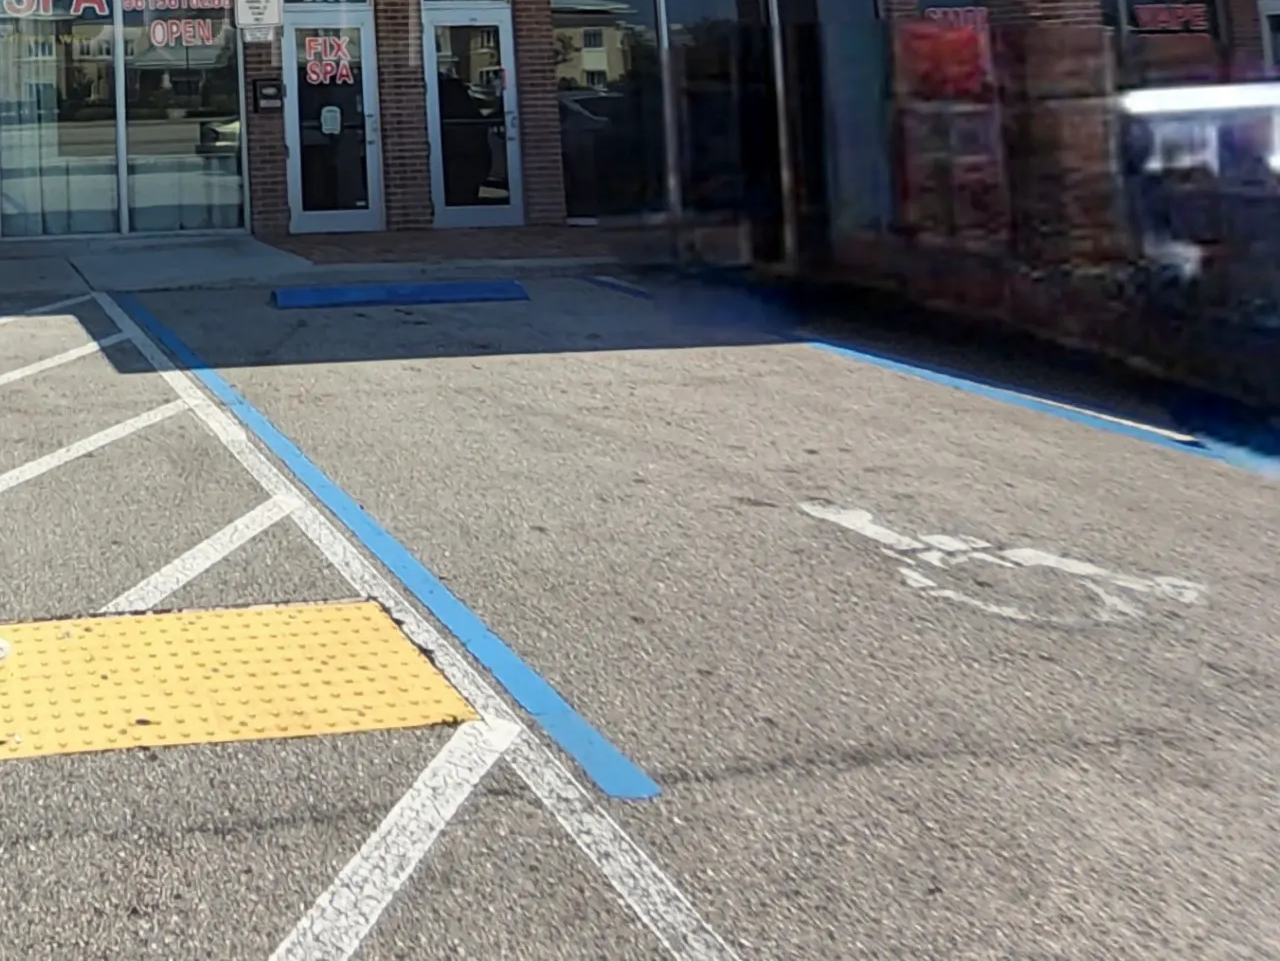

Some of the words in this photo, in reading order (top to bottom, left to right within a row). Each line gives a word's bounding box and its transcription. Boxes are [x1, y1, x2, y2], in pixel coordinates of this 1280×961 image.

[1132, 3, 1209, 30] VAPE
[151, 18, 214, 47] OPEN
[305, 36, 352, 60] FIX
[306, 60, 355, 85] SPA
